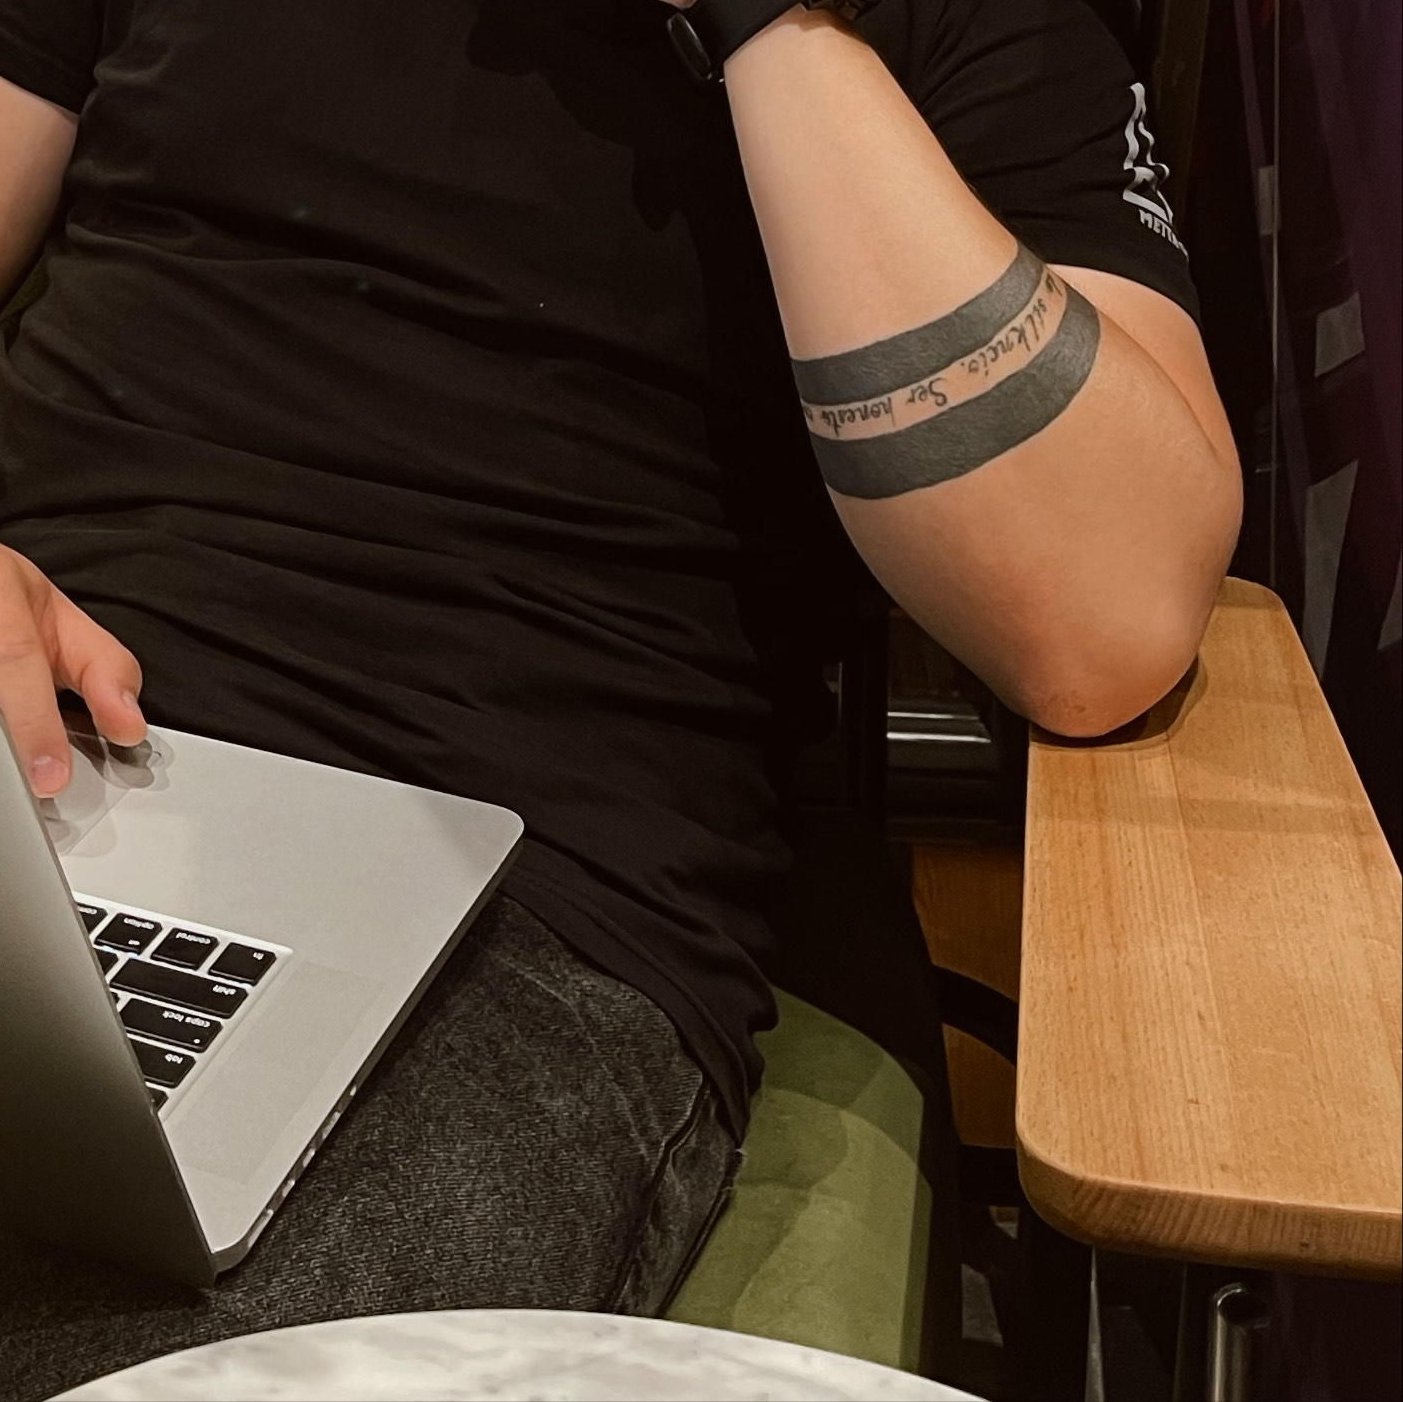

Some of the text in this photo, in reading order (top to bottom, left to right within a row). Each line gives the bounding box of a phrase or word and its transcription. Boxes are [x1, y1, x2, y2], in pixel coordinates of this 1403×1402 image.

[905, 378, 948, 407] Ser
[124, 917, 154, 930] option
[176, 932, 210, 944] control
[213, 985, 236, 995] shift
[162, 1011, 210, 1028] caps lock
[165, 1053, 183, 1064] tab
